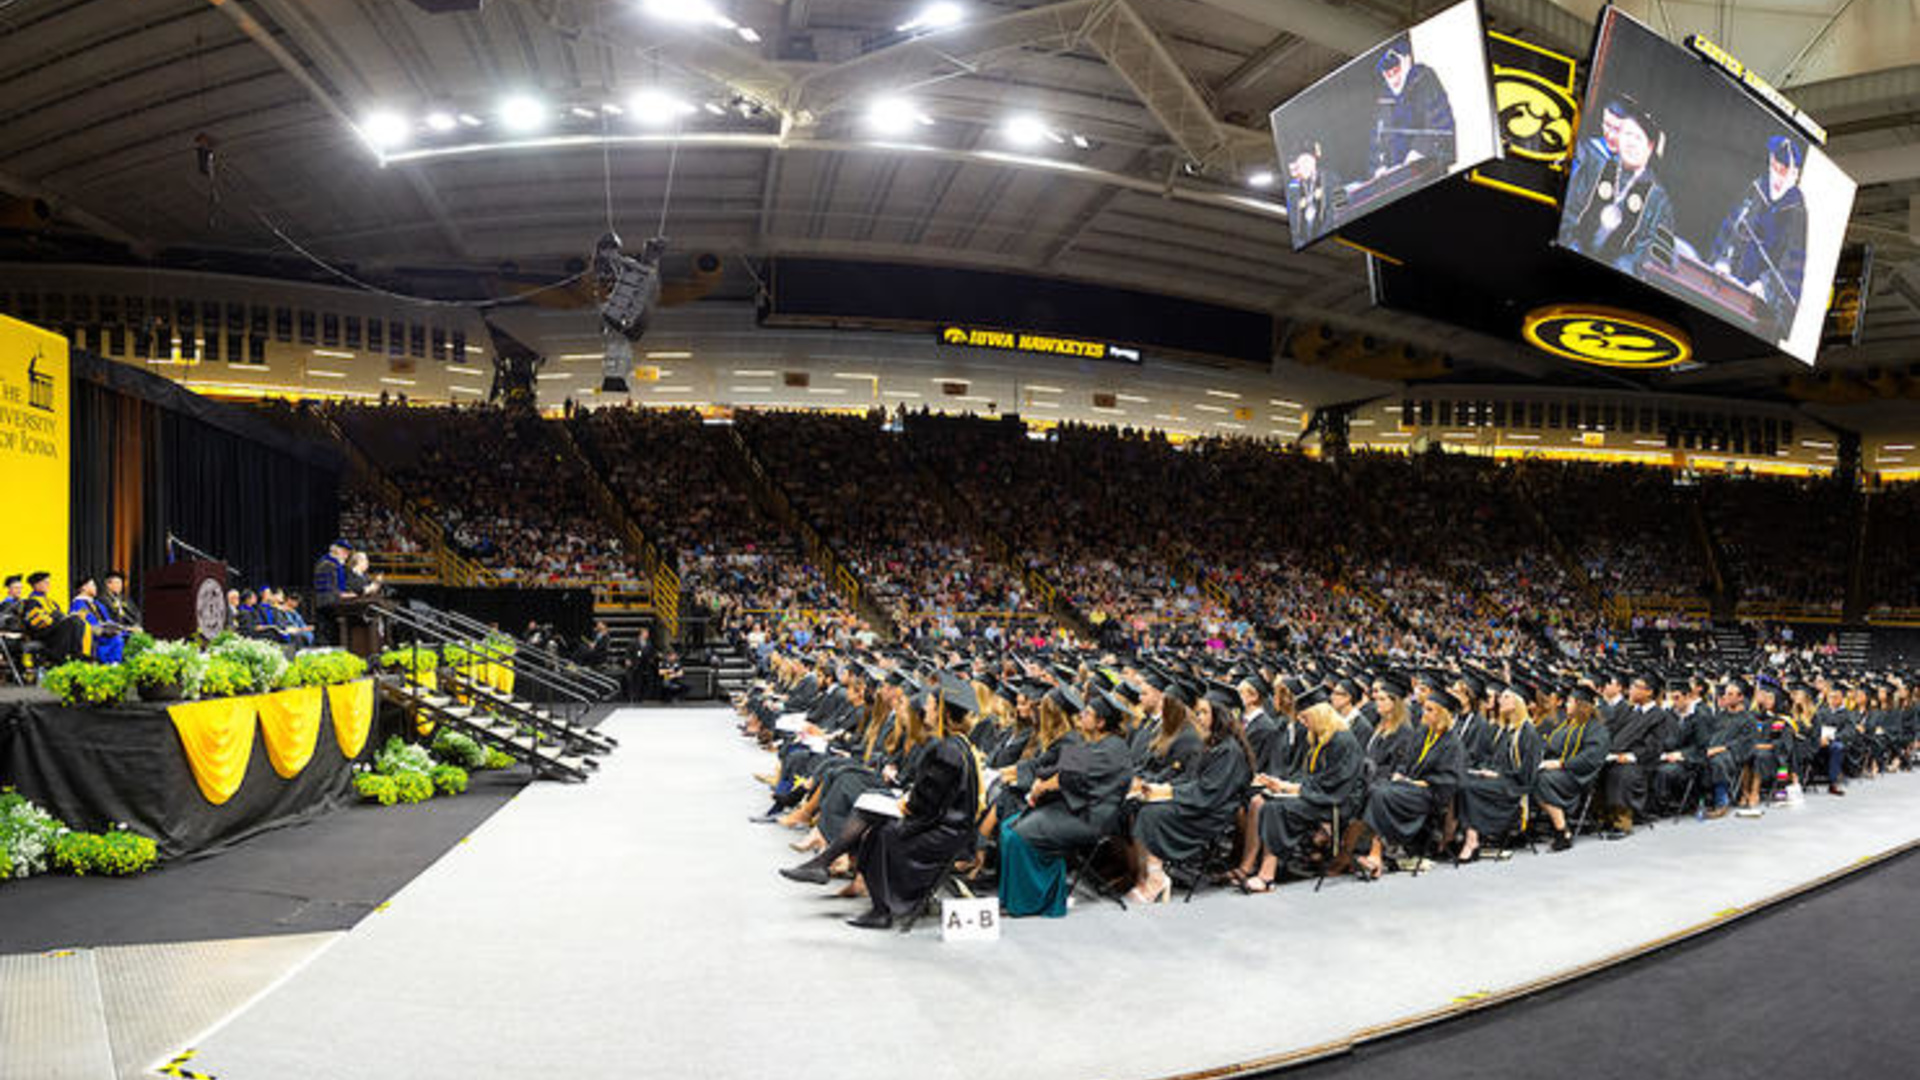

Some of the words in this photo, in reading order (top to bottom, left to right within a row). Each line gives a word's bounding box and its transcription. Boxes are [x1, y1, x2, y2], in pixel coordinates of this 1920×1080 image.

[969, 329, 1014, 348] IOWA
[1018, 334, 1105, 359] HAWKEYES
[947, 910, 962, 929] A
[979, 910, 994, 929] B
